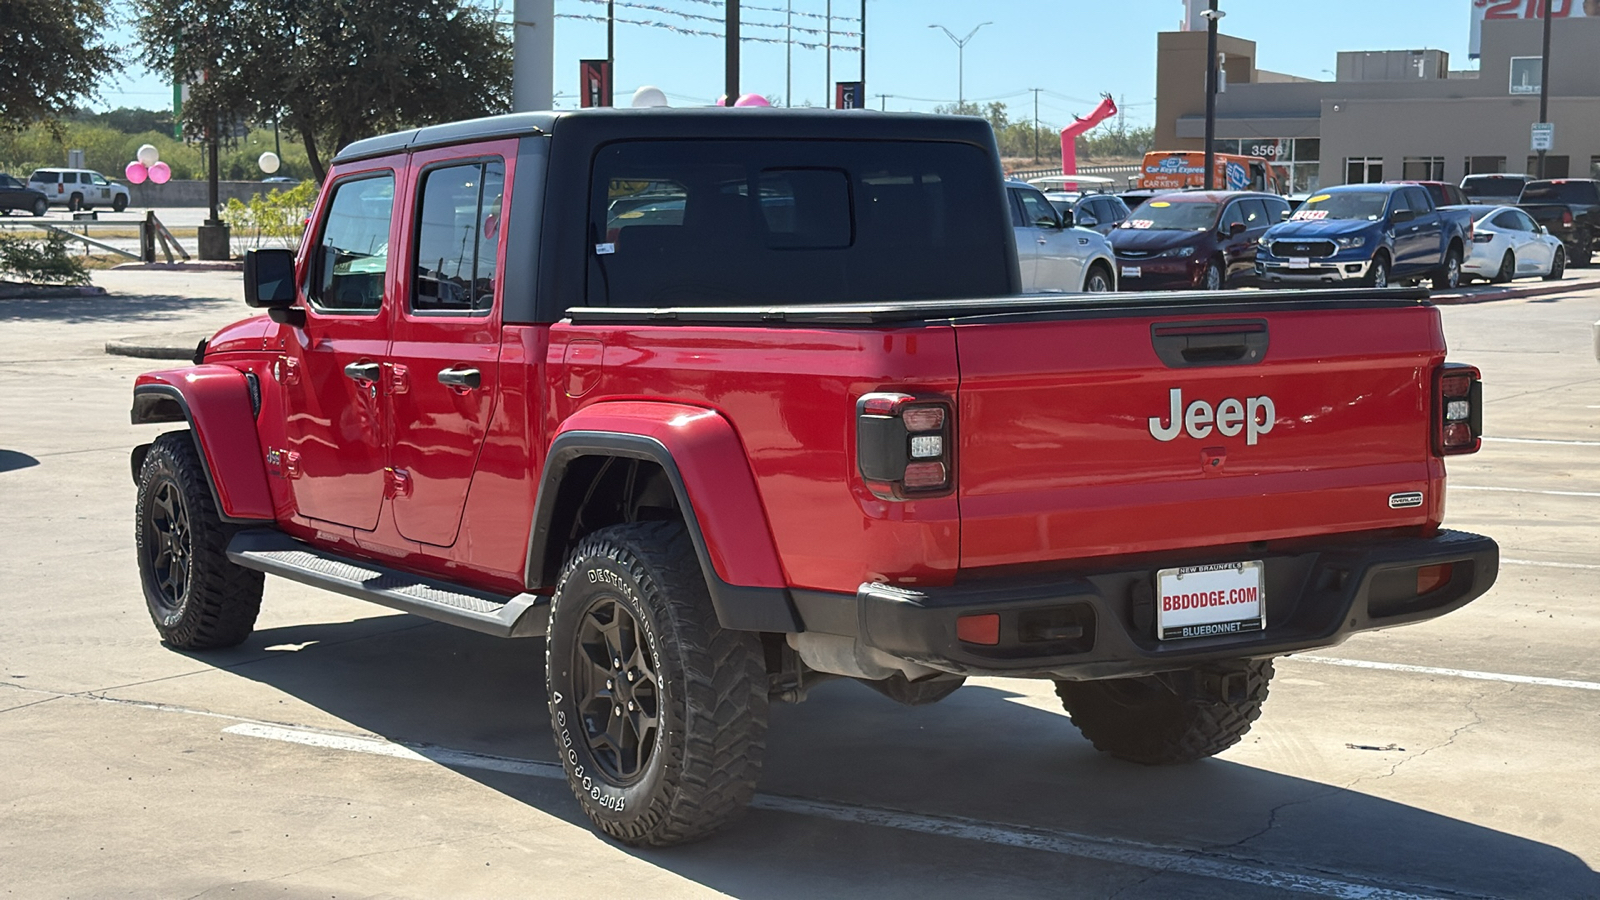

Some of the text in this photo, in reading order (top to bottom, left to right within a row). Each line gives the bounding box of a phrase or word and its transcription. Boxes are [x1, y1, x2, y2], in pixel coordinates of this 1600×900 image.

[1251, 145, 1283, 156] 3566
[1160, 166, 1178, 174] Keys
[1143, 180, 1161, 188] CAR
[1161, 180, 1179, 188] KEYS
[1148, 387, 1276, 446] Jeep
[1391, 496, 1422, 505] OVERLAND
[1179, 562, 1242, 574] NEW BRAUNFELS
[1162, 586, 1257, 612] BBDODGE.COM
[587, 568, 661, 668] DESTINATION
[1182, 622, 1242, 637] BLUEBONNET
